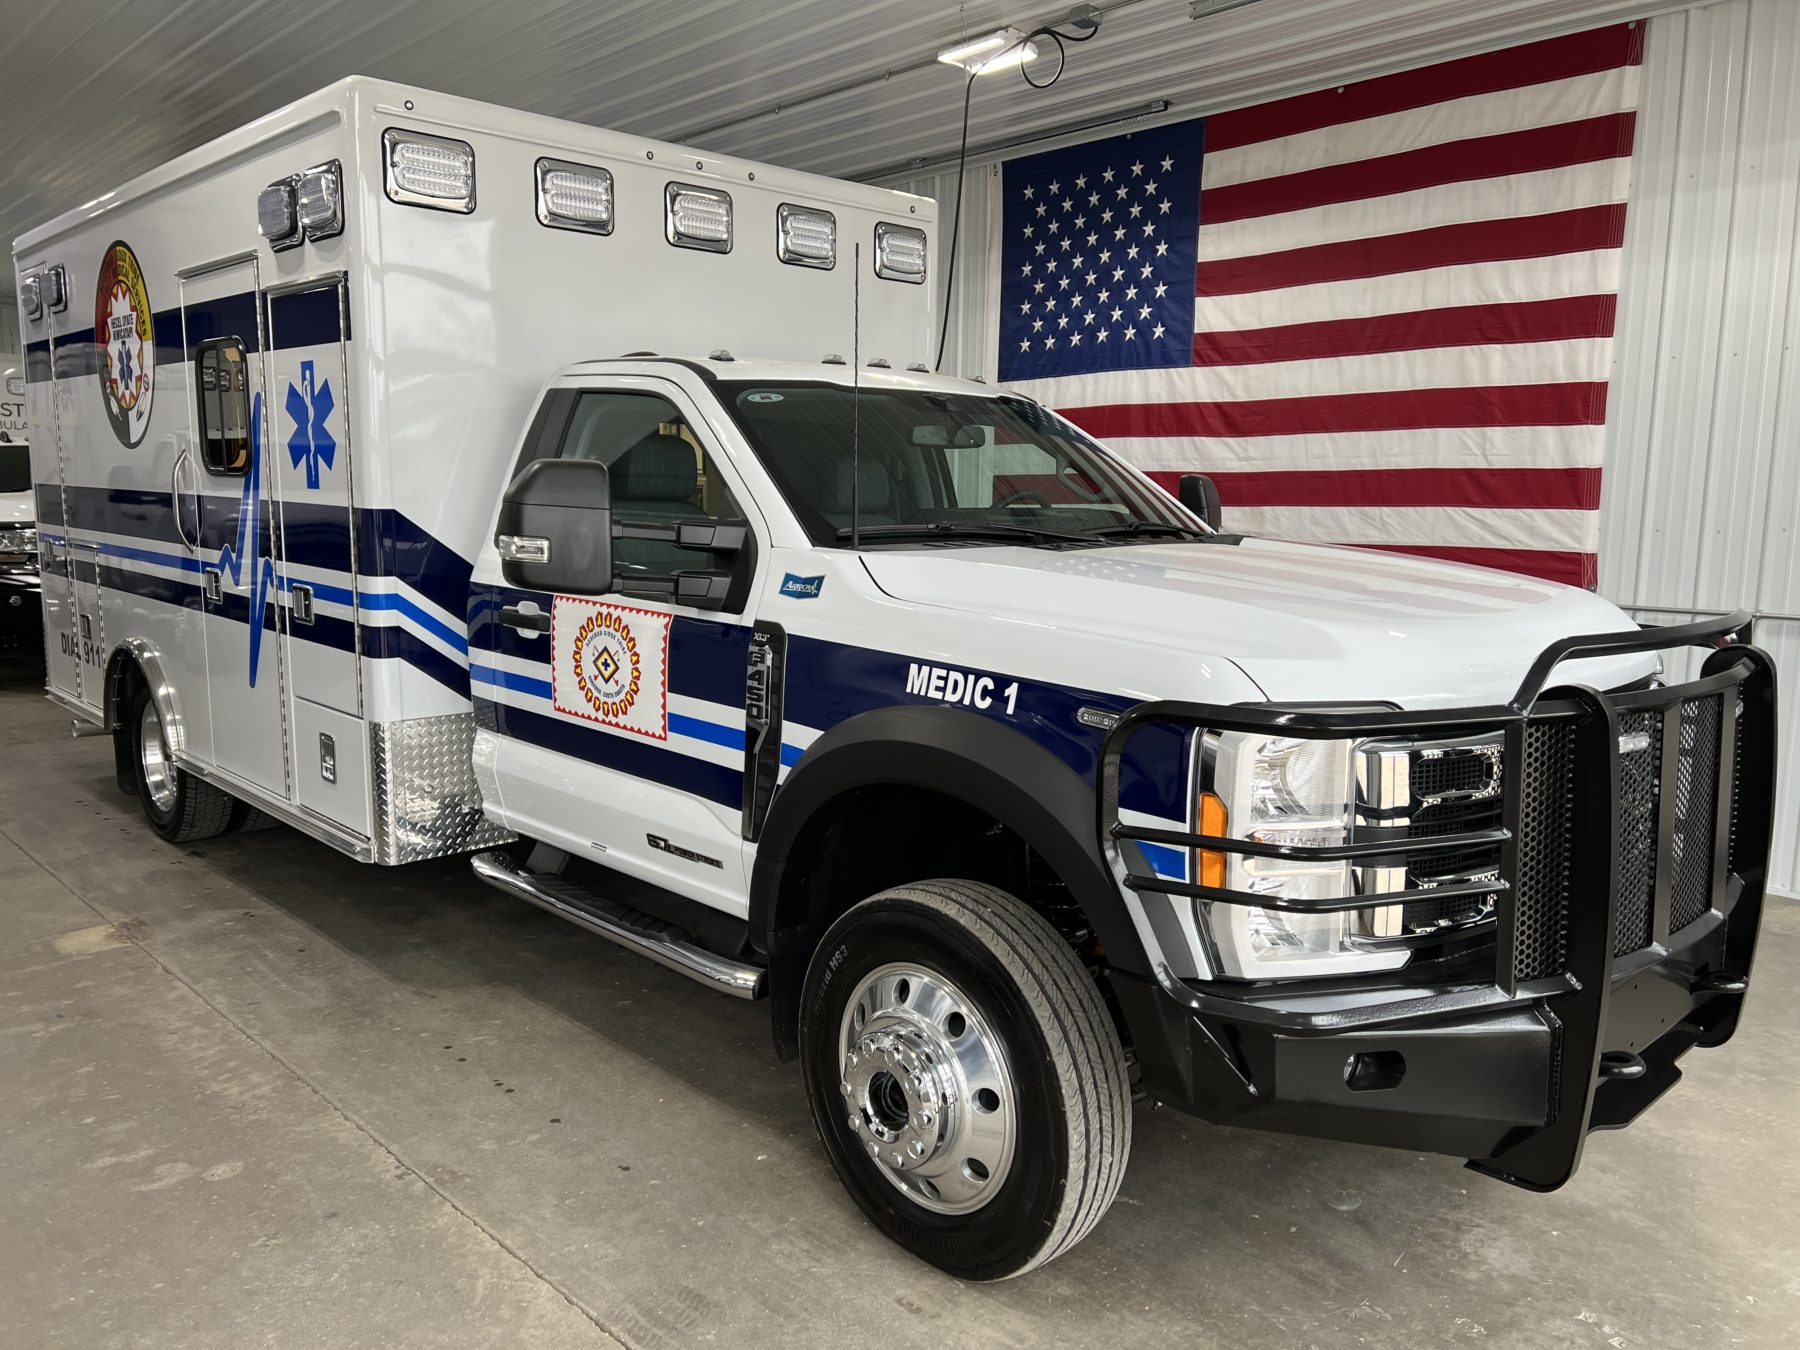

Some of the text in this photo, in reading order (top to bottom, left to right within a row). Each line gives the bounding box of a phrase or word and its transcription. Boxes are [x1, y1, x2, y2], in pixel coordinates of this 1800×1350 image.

[753, 632, 770, 642] XLT
[83, 641, 101, 669] 911
[905, 663, 1019, 715] MEDIC 1
[829, 944, 849, 972] HS3
